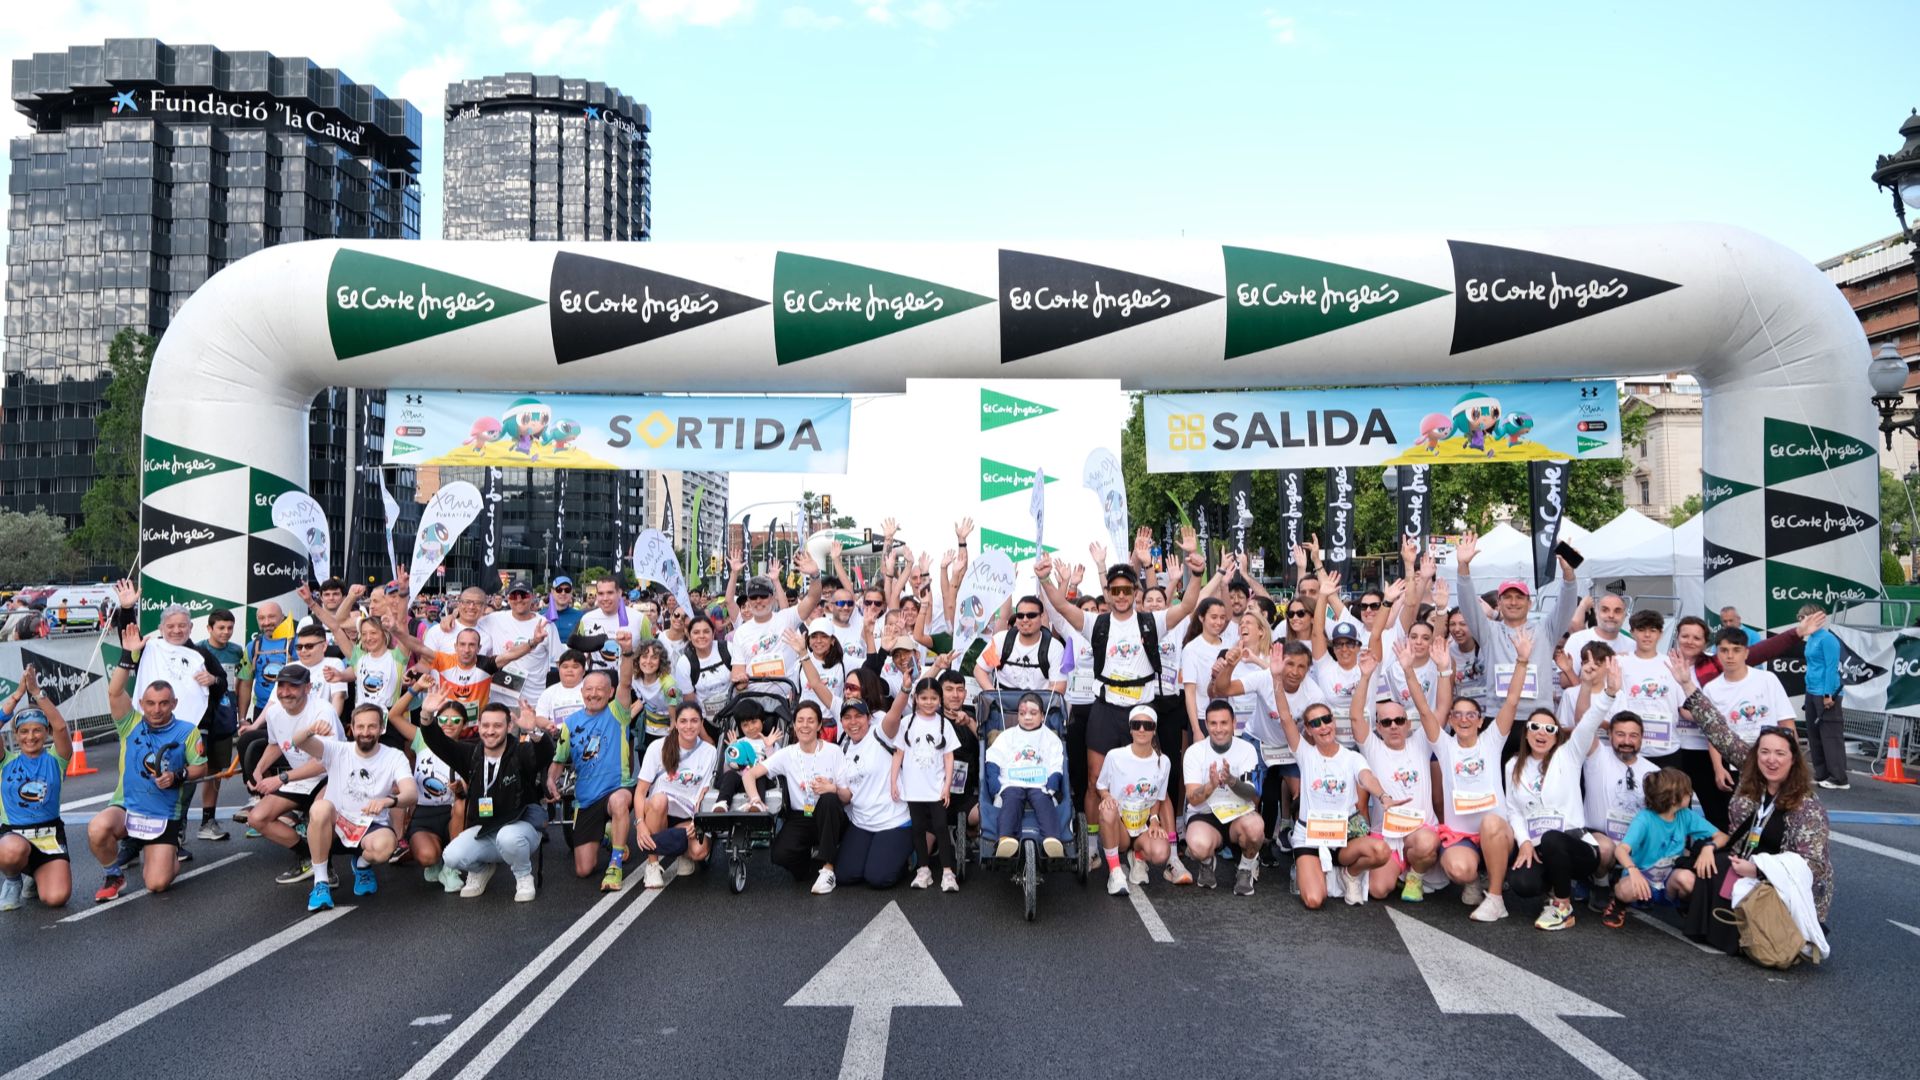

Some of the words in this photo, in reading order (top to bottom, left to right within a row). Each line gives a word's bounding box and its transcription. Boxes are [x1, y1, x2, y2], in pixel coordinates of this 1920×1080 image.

[150, 90, 268, 121] Fundació
[337, 286, 358, 309] El
[361, 286, 414, 310] Corte
[419, 283, 495, 320] Inglés
[560, 289, 581, 313] El
[585, 290, 637, 313] Corte
[642, 287, 718, 322] Inglés
[784, 289, 805, 312] El
[809, 290, 861, 312] Corte
[866, 285, 943, 320] Inglés
[1010, 287, 1031, 310] El
[1035, 287, 1088, 310] Corte
[1093, 282, 1170, 318] Inglés
[1237, 283, 1259, 306] El
[1263, 283, 1316, 306] Corte
[1322, 277, 1399, 314] Inglés
[1466, 278, 1488, 302] El
[1492, 278, 1545, 302] Corte
[1550, 272, 1628, 309] Inglés
[1212, 408, 1397, 451] SALIDA
[150, 458, 171, 473] Corte
[171, 455, 216, 475] Inglés
[1770, 443, 1784, 457] El
[1786, 443, 1821, 457] Corte
[486, 465, 503, 502] Ing
[1330, 466, 1352, 509] Inglé
[1402, 464, 1429, 494] Ing
[1540, 467, 1562, 522] Corte
[1282, 472, 1302, 518] Inglés
[1332, 510, 1347, 546] Corte
[1405, 495, 1423, 537] Corte
[1771, 515, 1785, 528] El
[1787, 514, 1822, 528] Corte
[148, 527, 169, 541] Corte
[170, 525, 215, 544] Inglés
[1286, 518, 1298, 550] Corte
[253, 563, 265, 576] El
[267, 563, 292, 576] Corte
[485, 547, 495, 567] El
[1330, 547, 1346, 562] El
[1772, 587, 1787, 600] El
[1788, 587, 1823, 600] Corte
[36, 672, 58, 688] Corte
[503, 675, 512, 685] 9
[1773, 659, 1788, 672] El
[1894, 658, 1907, 676] El
